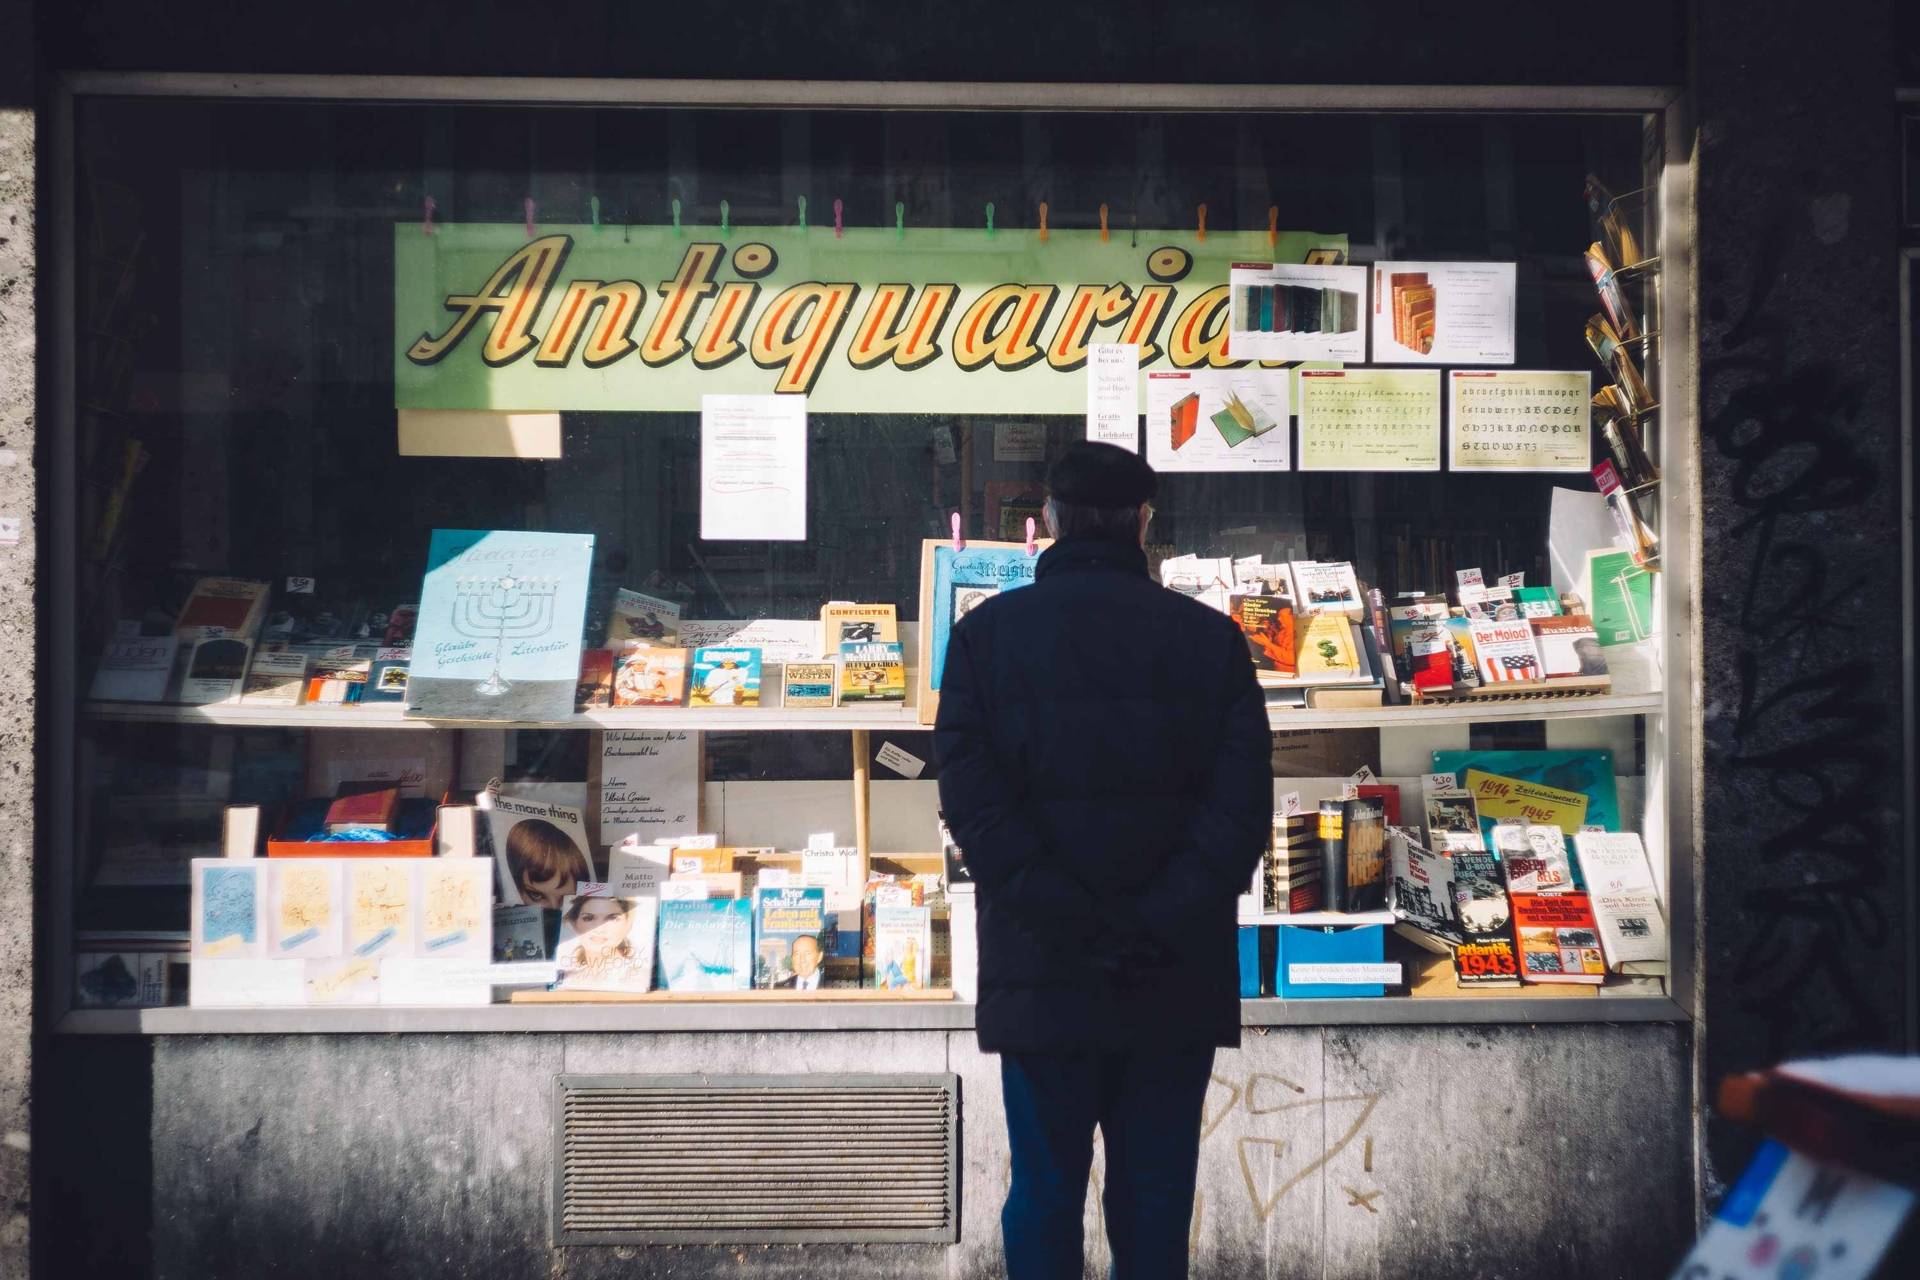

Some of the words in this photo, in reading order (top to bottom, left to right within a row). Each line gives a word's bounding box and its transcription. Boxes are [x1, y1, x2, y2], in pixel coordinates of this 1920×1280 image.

[405, 233, 1345, 398] Antiquaria
[1476, 632, 1495, 642] Der
[1495, 627, 1529, 641] Moloch
[494, 794, 512, 810] the
[515, 803, 547, 816] mane
[549, 804, 578, 824] thing
[1520, 804, 1556, 821] 1945
[805, 849, 834, 858] Christa
[624, 873, 654, 881] Matto
[622, 881, 656, 890] regiert
[1458, 943, 1513, 956] Atlantik
[1459, 954, 1517, 976] 1943
